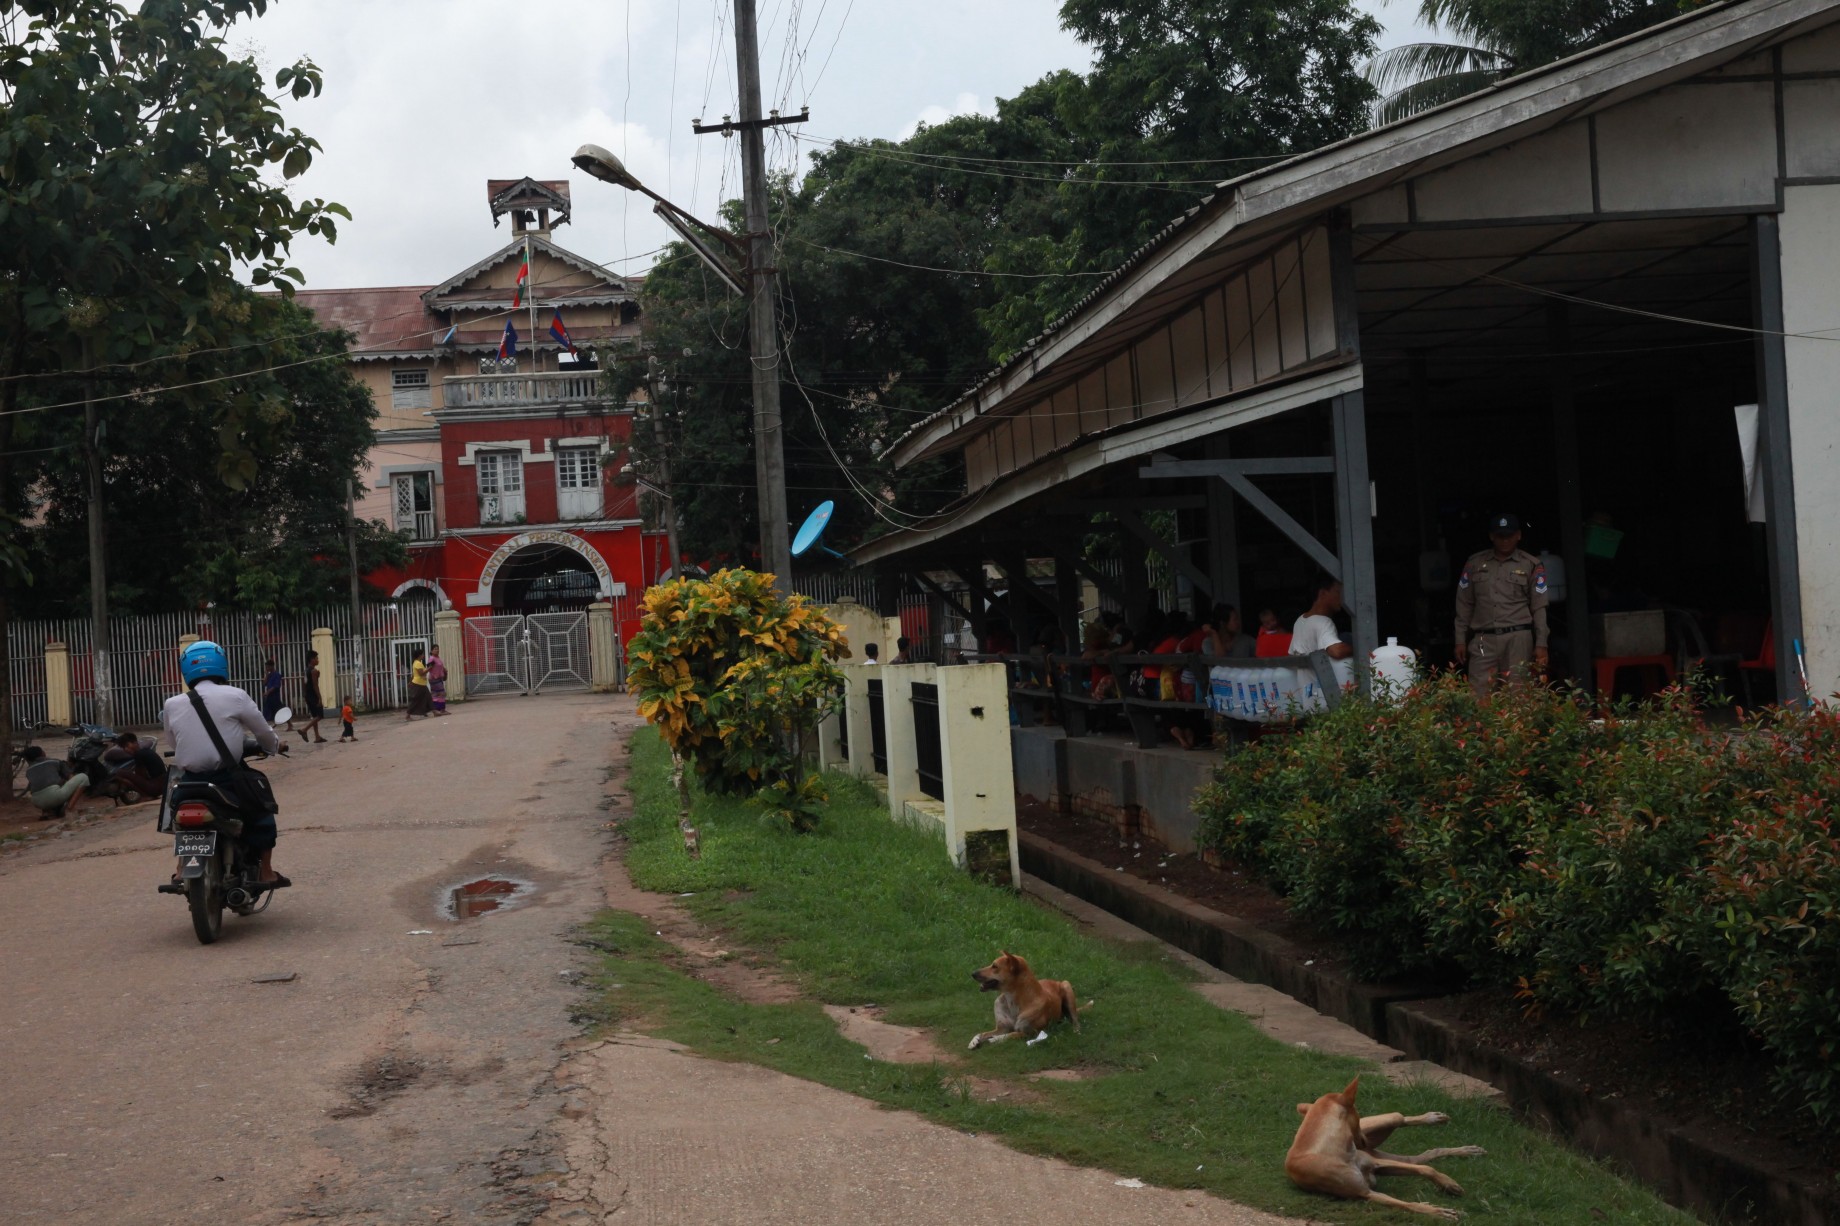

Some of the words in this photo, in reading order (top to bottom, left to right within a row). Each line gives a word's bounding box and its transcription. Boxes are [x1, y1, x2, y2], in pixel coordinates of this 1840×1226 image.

[481, 536, 525, 587] CENTRAL
[577, 540, 608, 578] INSEIN
[178, 845, 210, 854] ၃၈၈၄၃
